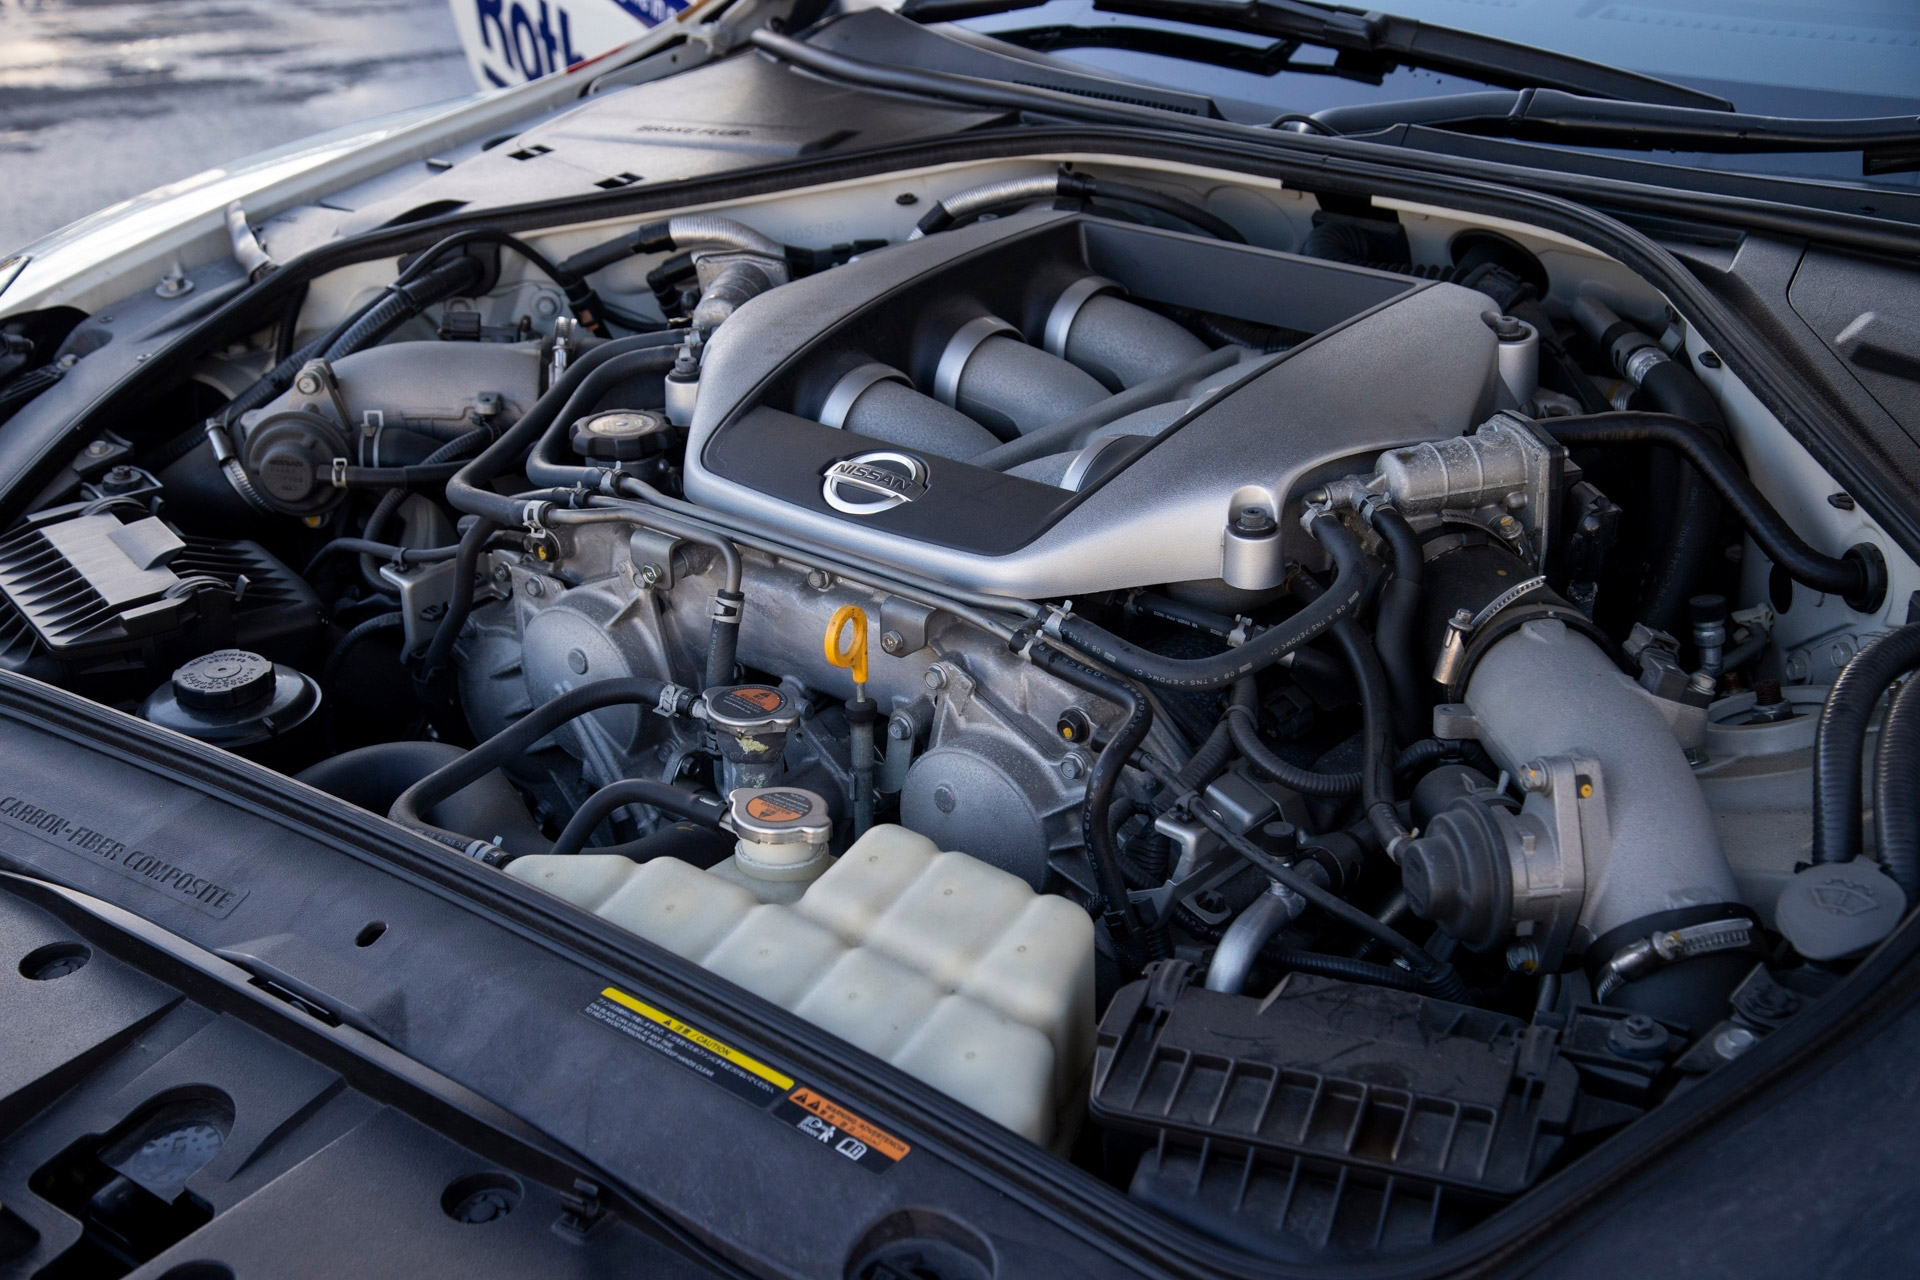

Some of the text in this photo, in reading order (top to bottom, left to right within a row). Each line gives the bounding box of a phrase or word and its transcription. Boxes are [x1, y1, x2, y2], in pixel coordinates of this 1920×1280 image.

[833, 463, 913, 492] NISSAN
[1311, 620, 1326, 631] TNS
[1068, 630, 1082, 646] TNS
[0, 796, 236, 909] CARBON-FIBER COMPOSITE
[605, 1017, 621, 1028] AVOID
[616, 1016, 627, 1025] CAN
[649, 1033, 662, 1042] ANY
[696, 1036, 731, 1056] CAUTION
